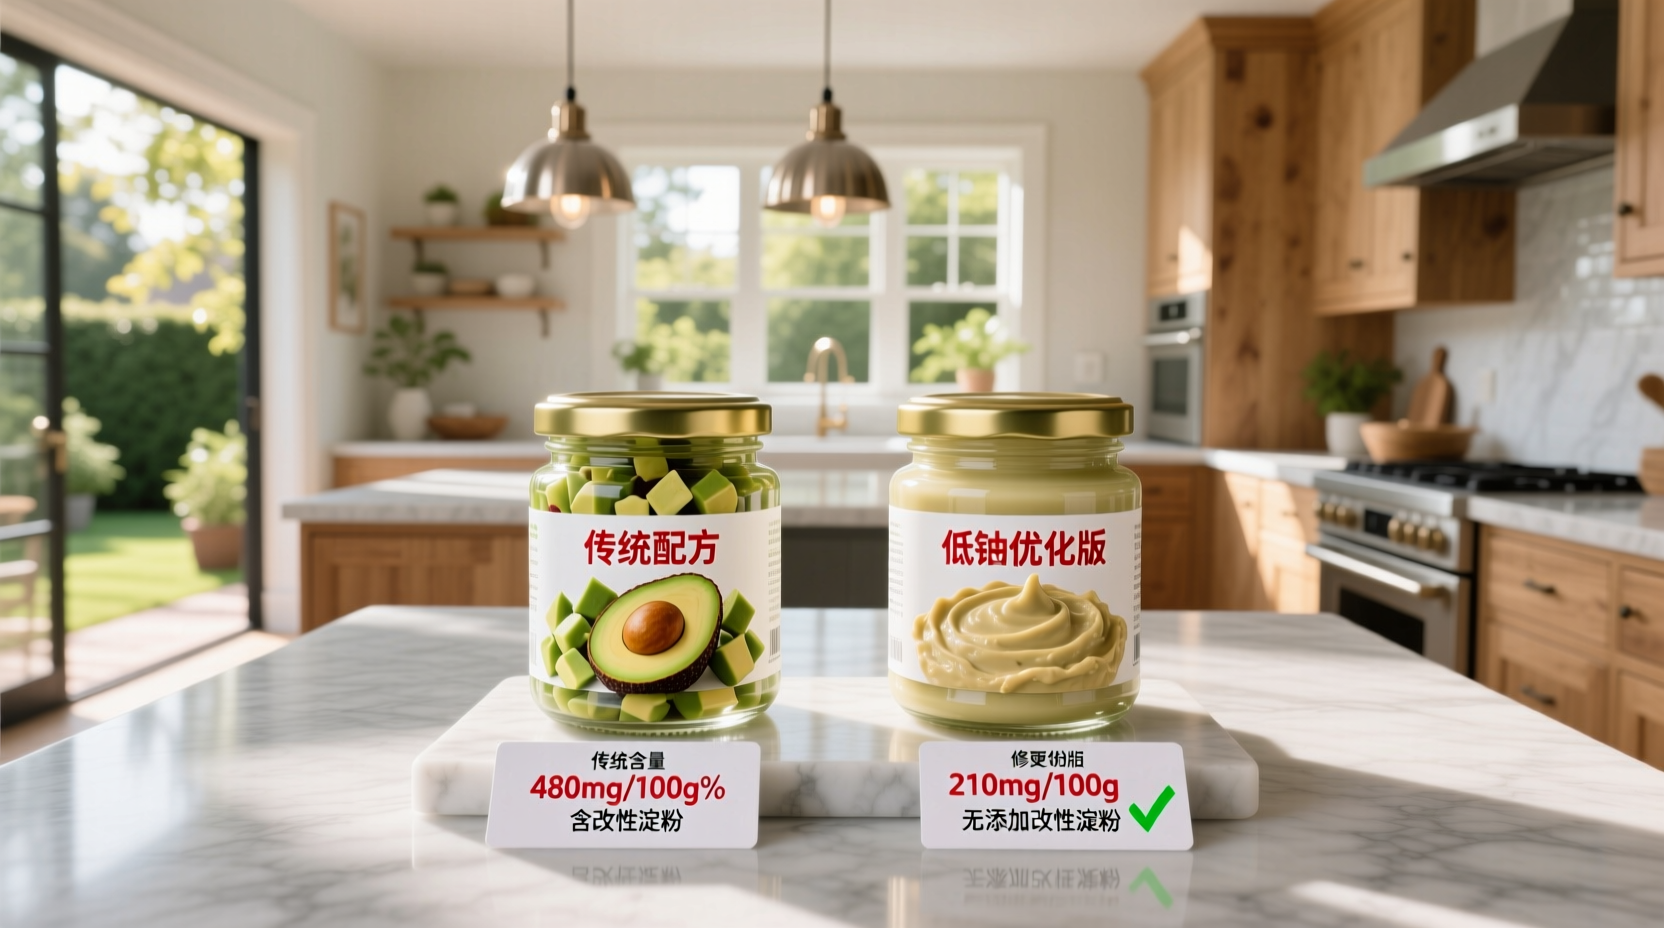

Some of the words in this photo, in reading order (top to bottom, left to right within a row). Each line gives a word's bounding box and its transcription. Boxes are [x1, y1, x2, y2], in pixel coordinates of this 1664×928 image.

[584, 529, 720, 566] 传统配方
[591, 751, 665, 771] 传统含量
[530, 774, 726, 806] 480mg/100g%
[949, 772, 1119, 803] 210mg/100g
[570, 808, 684, 832] 含改性淀粉
[962, 808, 1121, 833] 无添加改性淀粉
